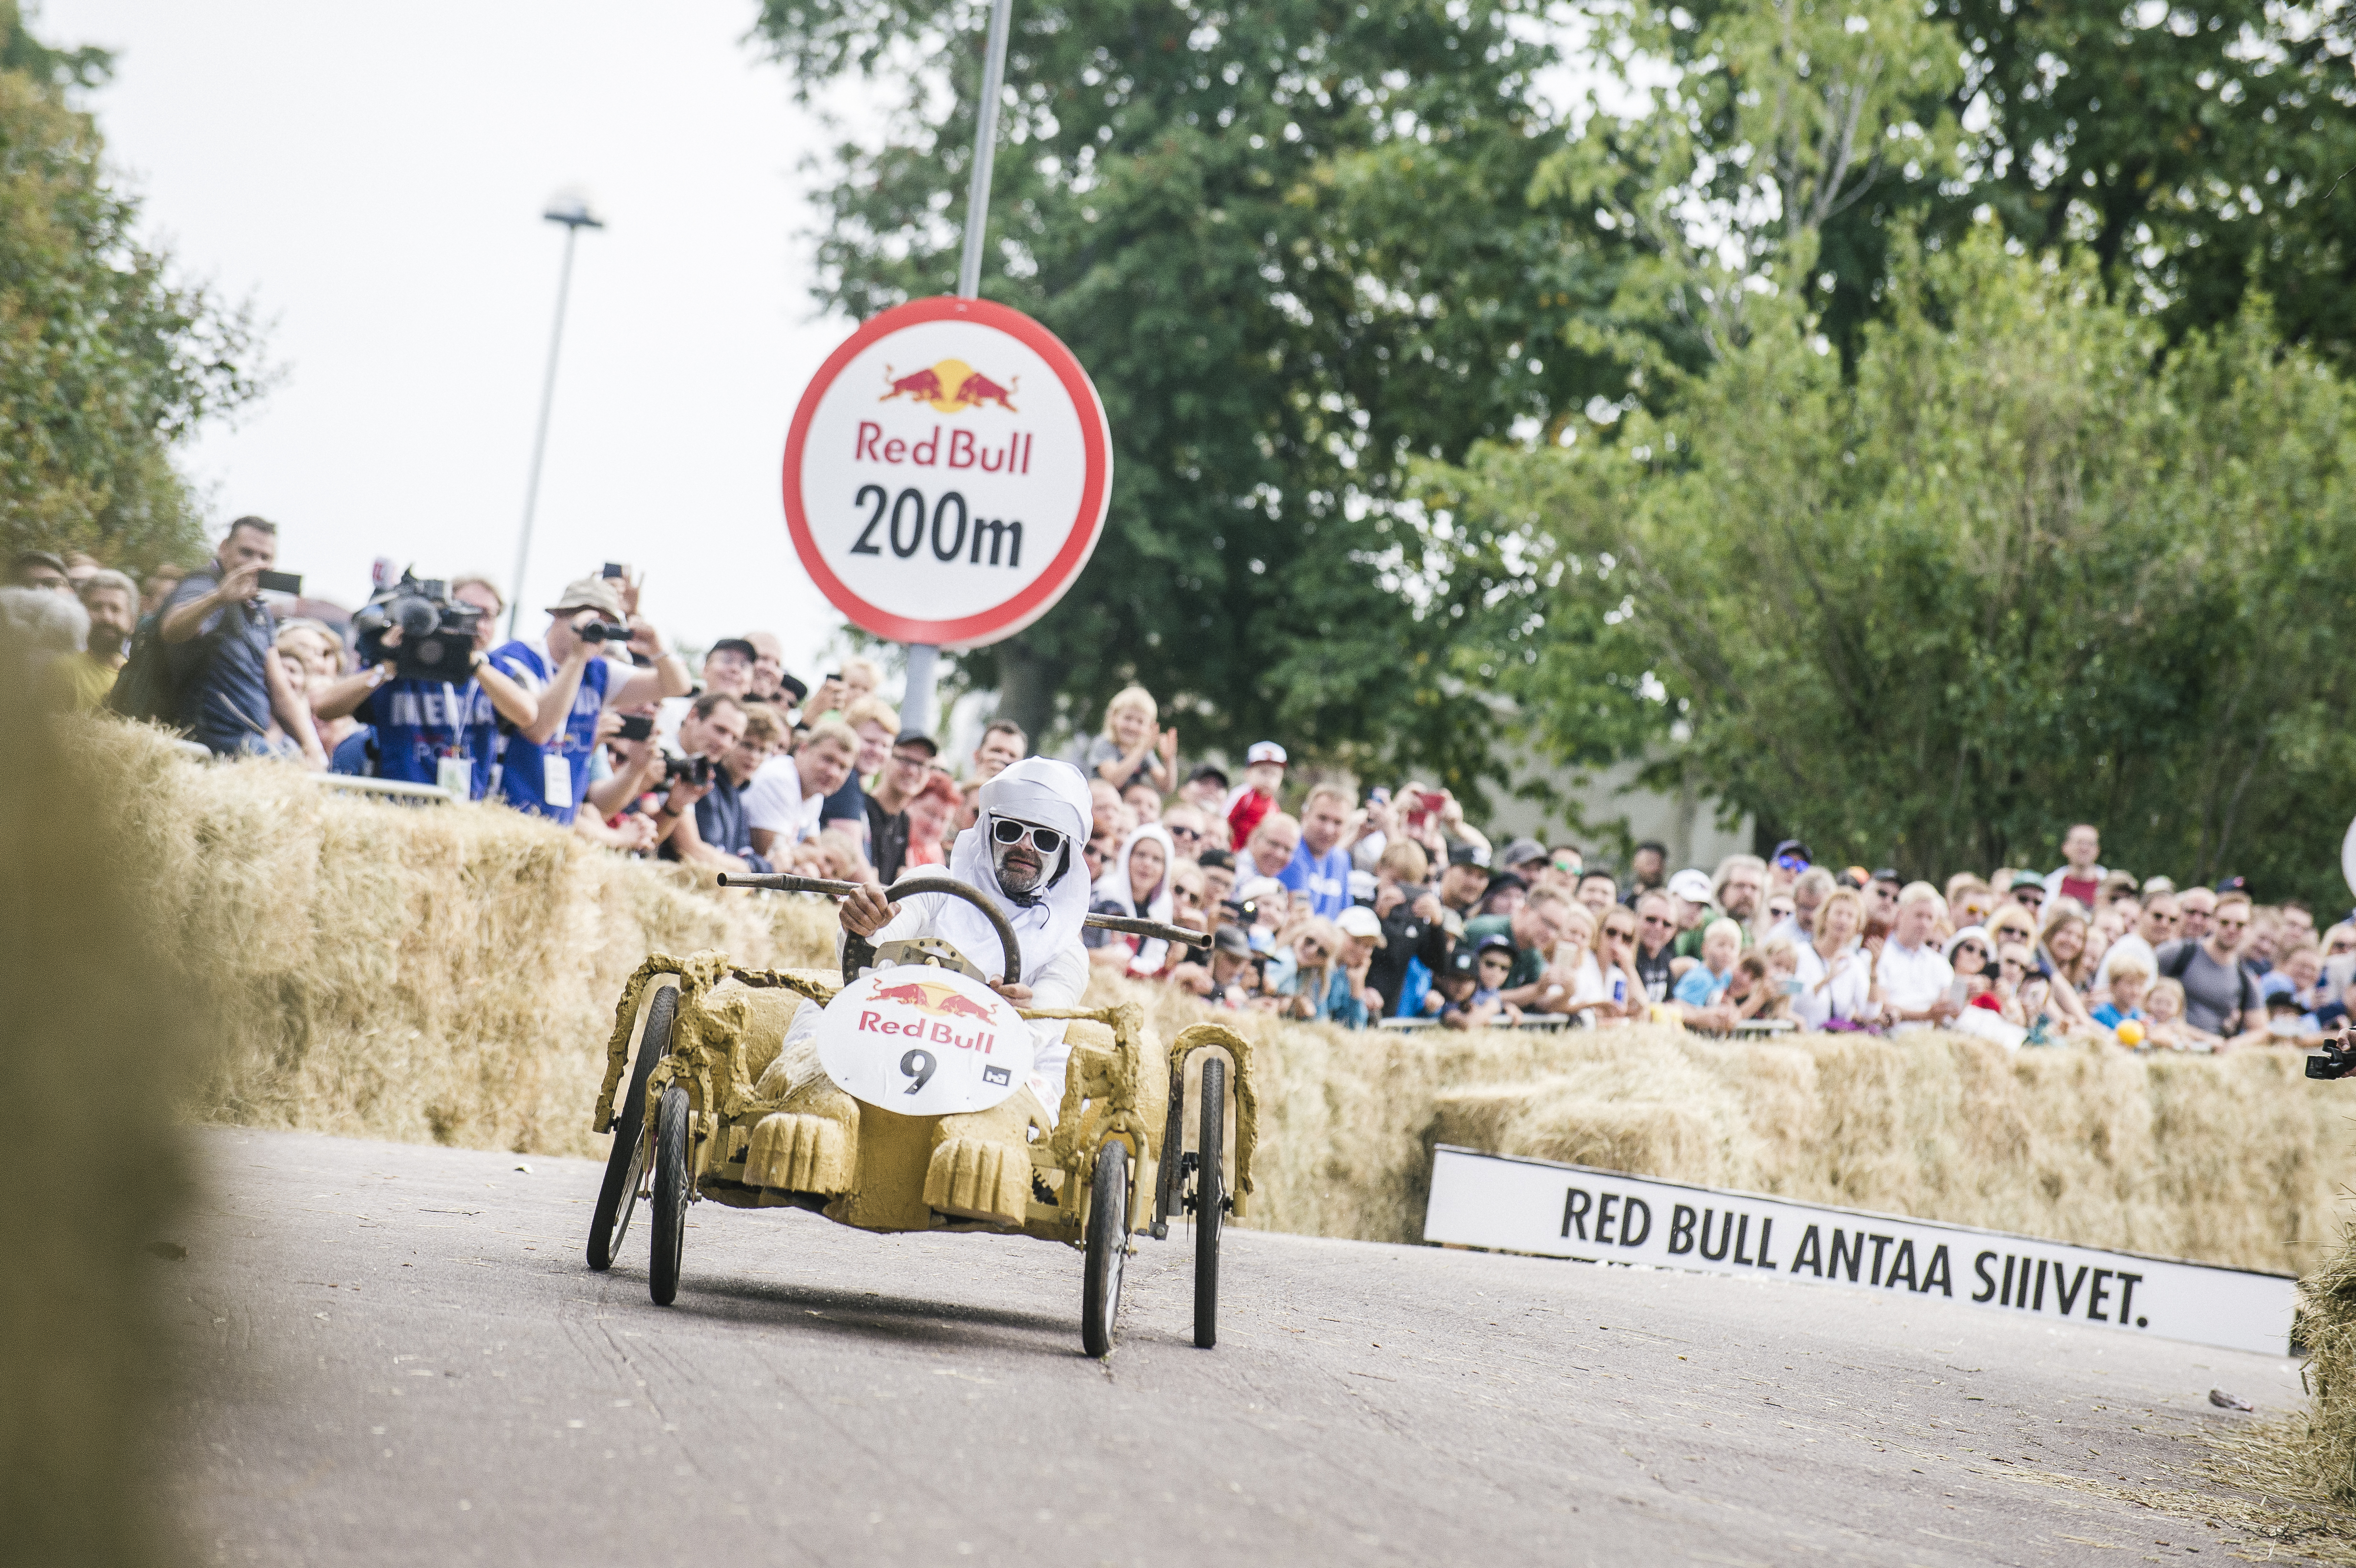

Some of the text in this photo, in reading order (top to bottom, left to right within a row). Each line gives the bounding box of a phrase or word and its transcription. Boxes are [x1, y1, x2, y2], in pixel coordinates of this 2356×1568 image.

[855, 421, 1032, 475] Red Bull
[850, 483, 1023, 568] 200m
[859, 1011, 994, 1054] Red Bull
[900, 1049, 937, 1095] 9
[1560, 1187, 2149, 1328] RED BULL ANTAA SIIIVET.
